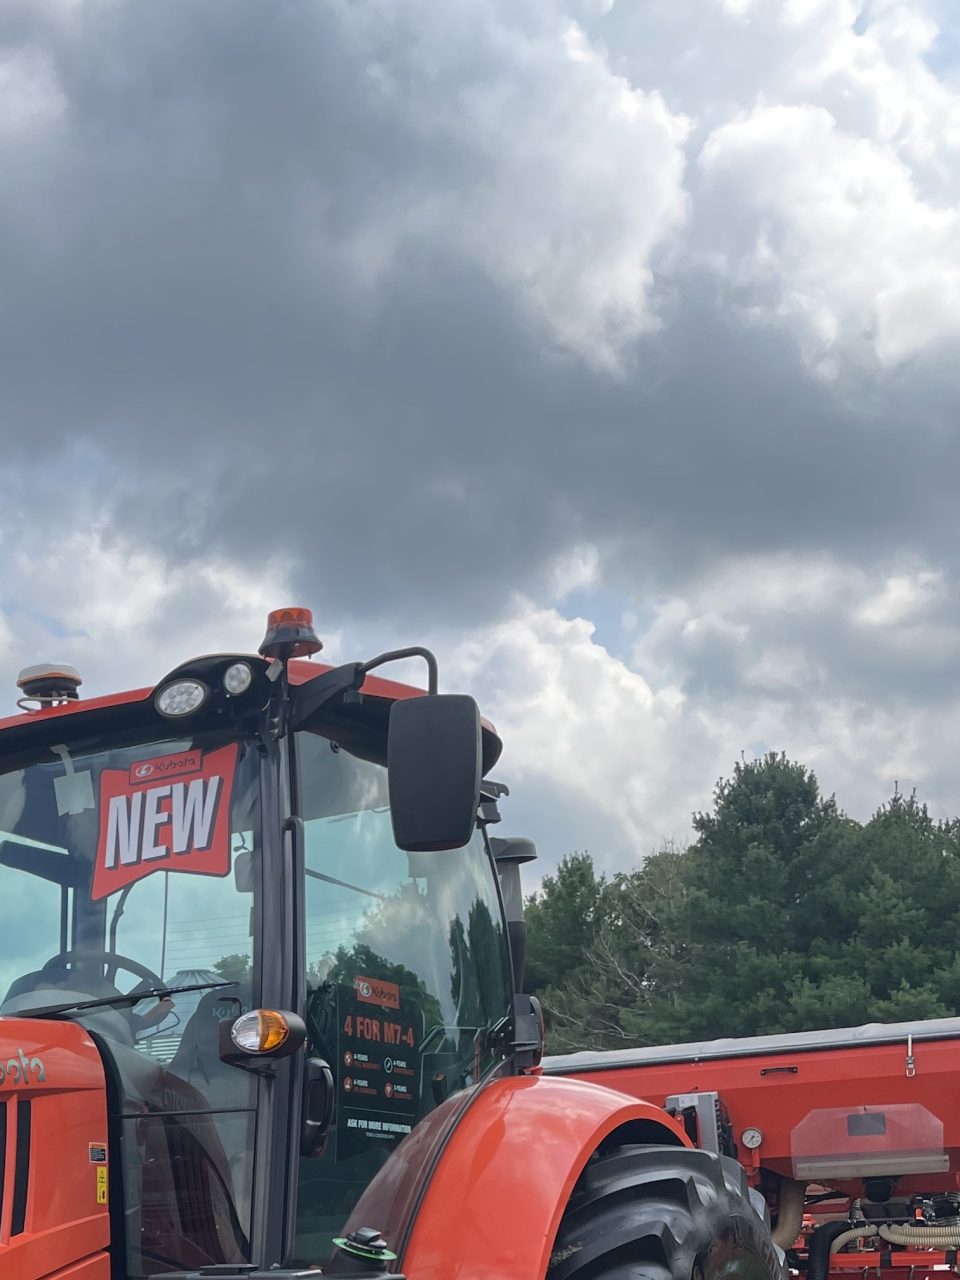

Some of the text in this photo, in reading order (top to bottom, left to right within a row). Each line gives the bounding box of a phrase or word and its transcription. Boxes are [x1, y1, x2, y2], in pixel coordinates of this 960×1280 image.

[155, 757, 196, 771] Kubota
[104, 774, 224, 870] NEW
[344, 1015, 415, 1048] 4 FOR M7-4
[347, 1118, 357, 1128] ASK
